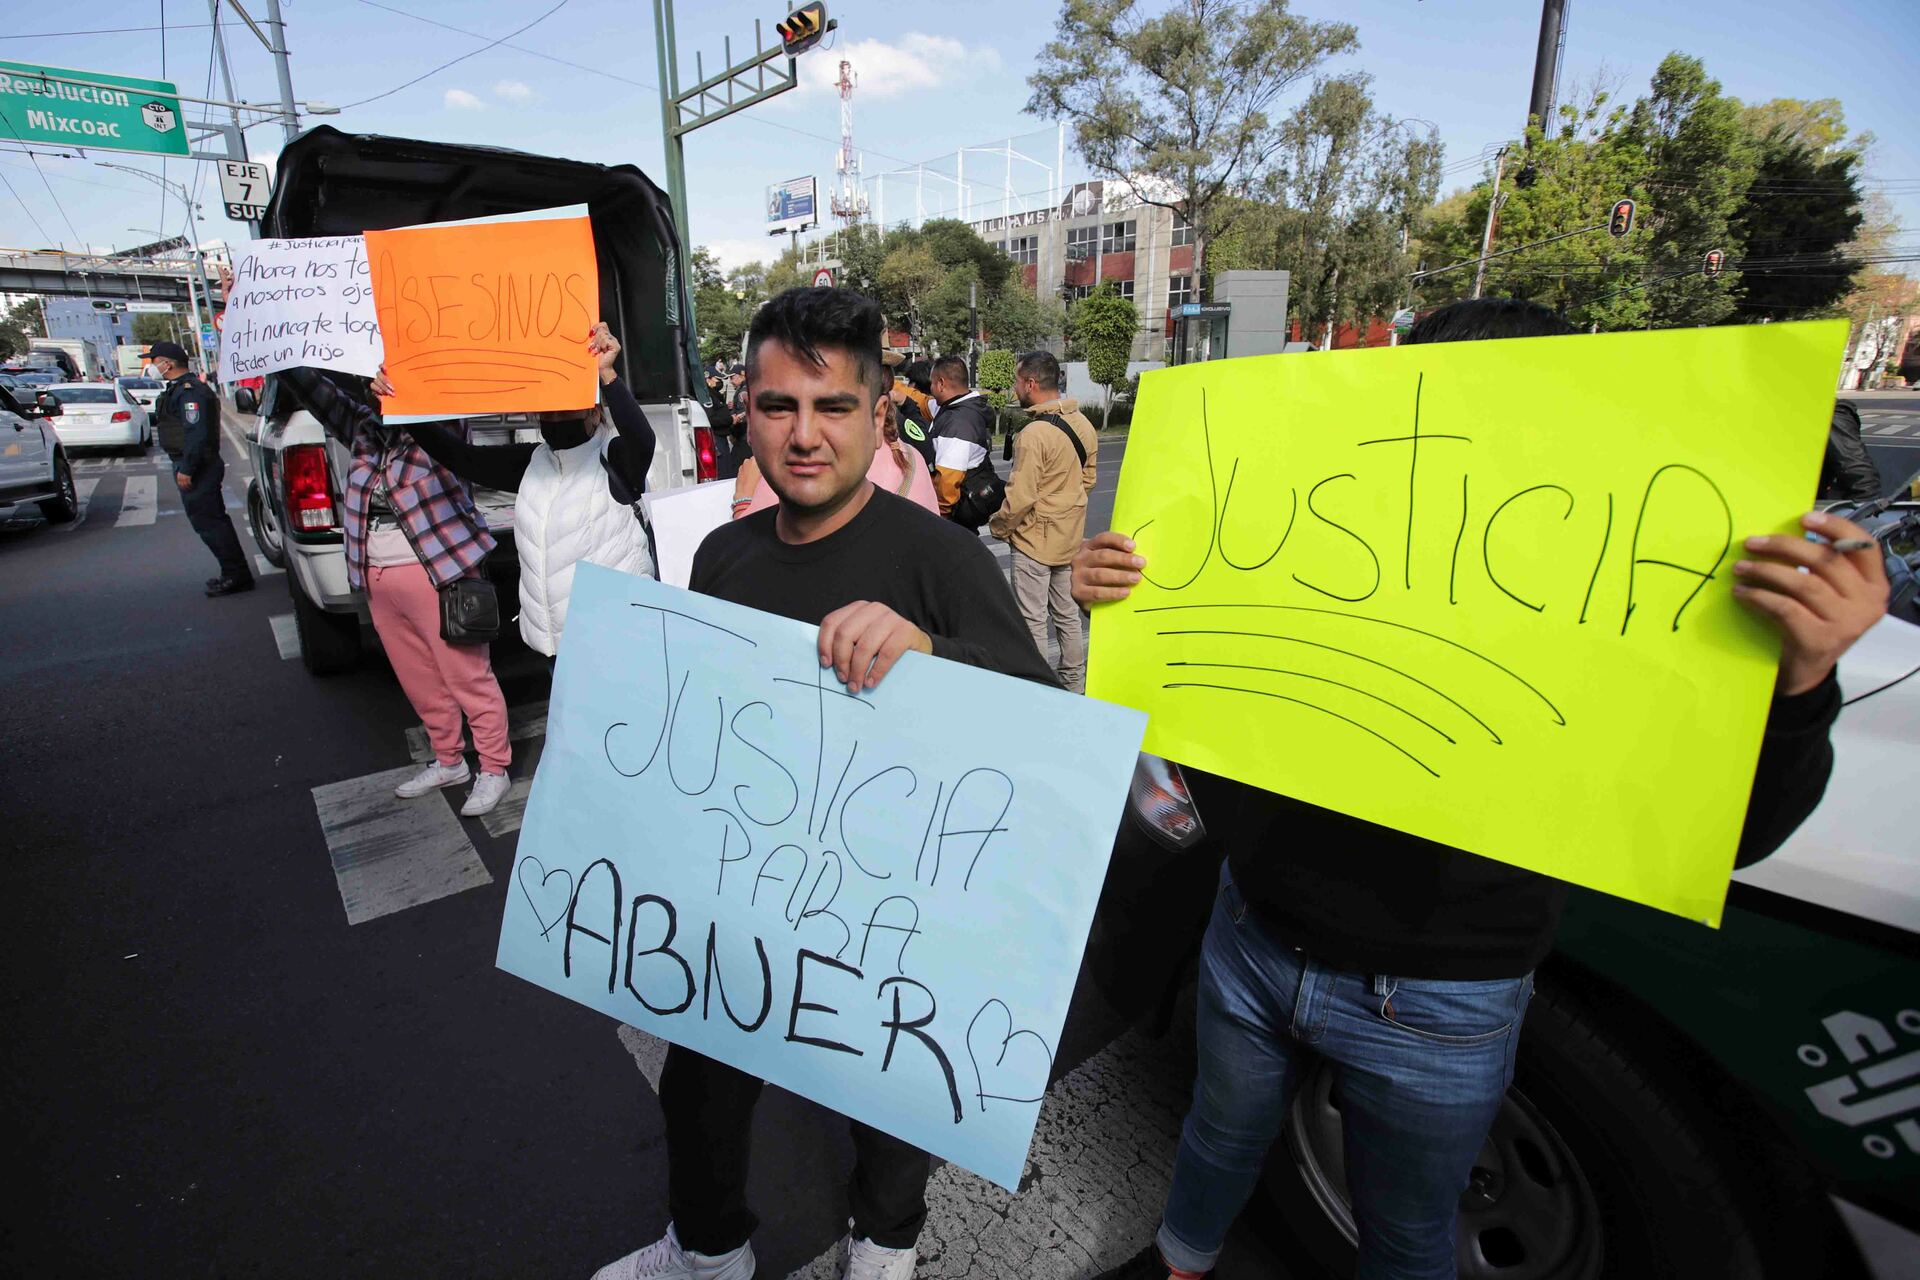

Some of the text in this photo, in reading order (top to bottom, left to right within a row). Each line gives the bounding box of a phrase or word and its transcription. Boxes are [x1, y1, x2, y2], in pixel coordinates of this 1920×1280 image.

[0, 73, 129, 107] Revolucion
[149, 104, 166, 112] CTO
[27, 109, 121, 138] Mixcoac
[226, 164, 260, 180] EJE
[239, 183, 252, 201] 7
[971, 210, 1045, 234] WILLAMS
[237, 255, 297, 282] Ahora
[305, 259, 338, 279] nos
[243, 285, 327, 309] nosotros
[377, 249, 592, 348] ASESINOS
[230, 340, 344, 374] Perder un hijo
[604, 603, 1014, 891] JUSTICIA
[564, 858, 963, 1123] ABNER
